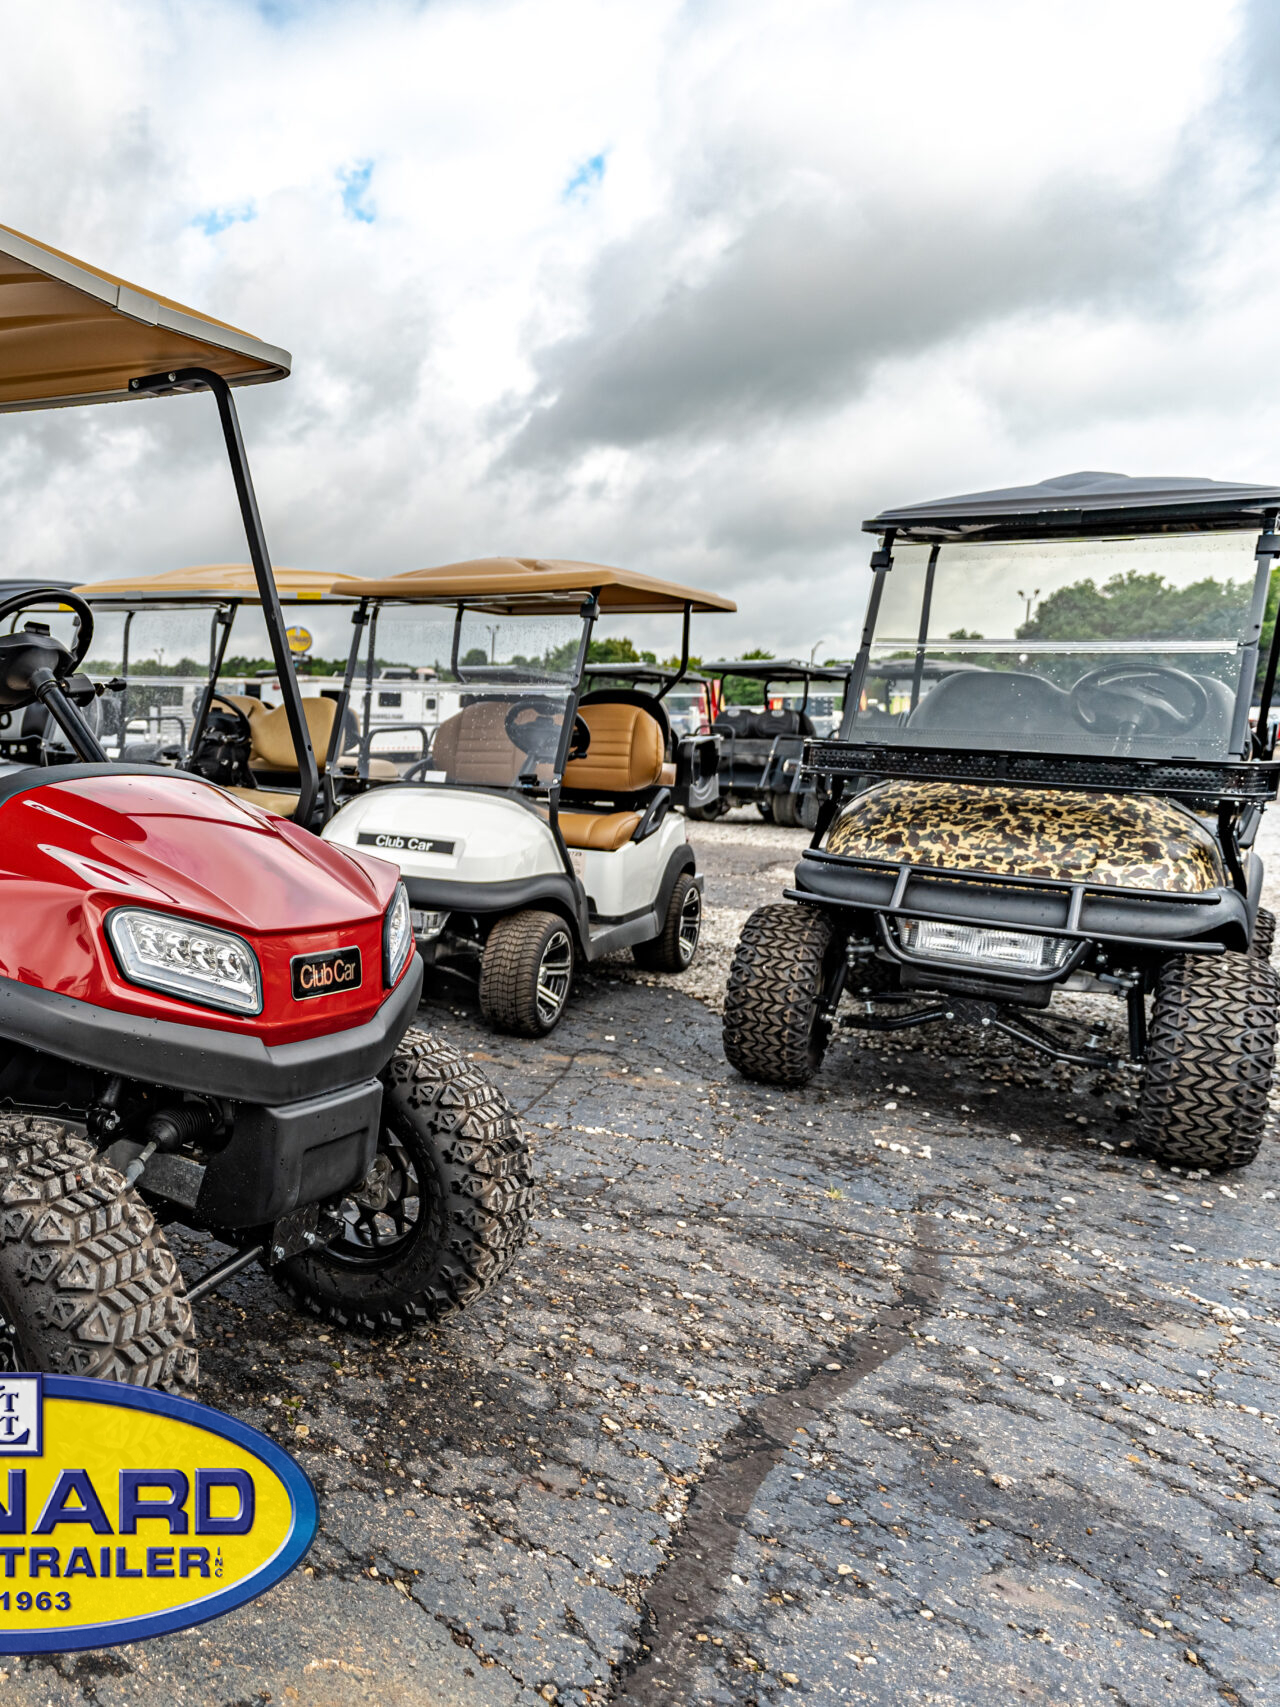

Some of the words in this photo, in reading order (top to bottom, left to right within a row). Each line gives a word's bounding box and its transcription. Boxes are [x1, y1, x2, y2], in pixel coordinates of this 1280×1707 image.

[376, 835, 404, 848] Club
[407, 838, 433, 851] Car
[300, 963, 333, 989] Club
[334, 959, 356, 982] Car
